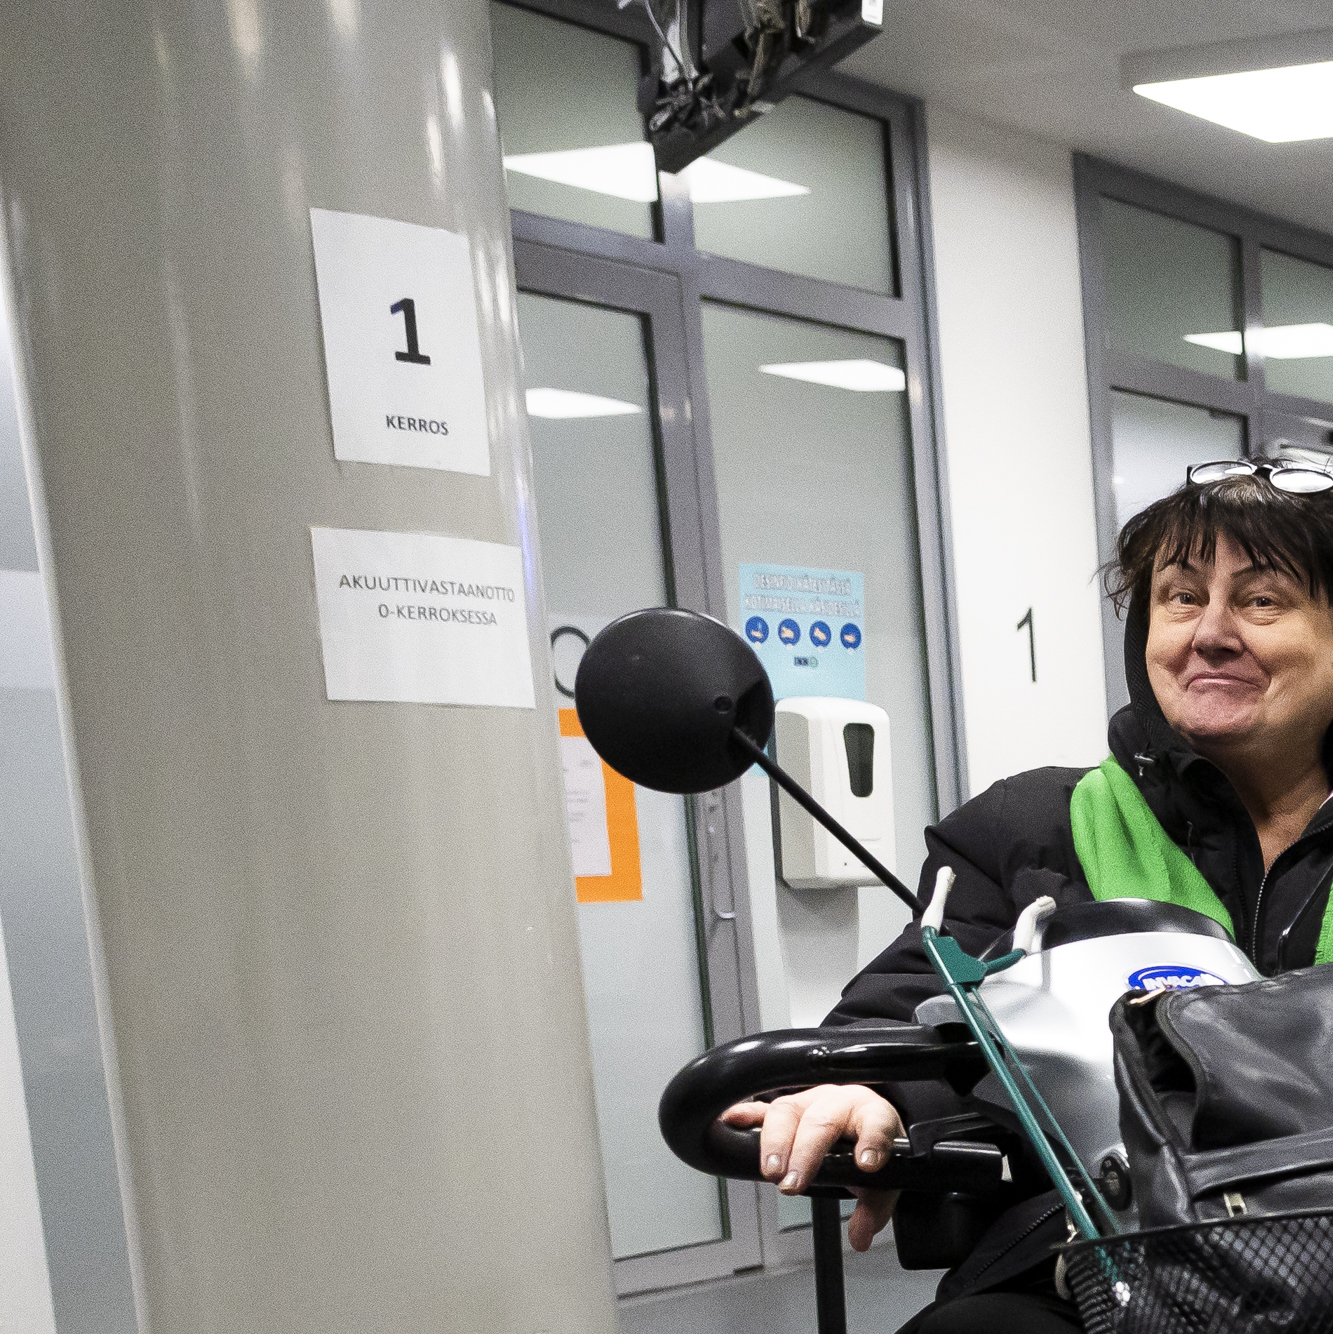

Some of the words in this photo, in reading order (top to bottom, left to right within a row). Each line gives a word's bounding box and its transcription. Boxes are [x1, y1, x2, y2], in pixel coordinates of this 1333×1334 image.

[390, 298, 431, 365] 1
[386, 415, 449, 436] KERROS
[339, 574, 516, 603] AKUUTTIVASTAANOTTO
[1016, 606, 1037, 682] 1
[1142, 973, 1224, 991] INVACA
